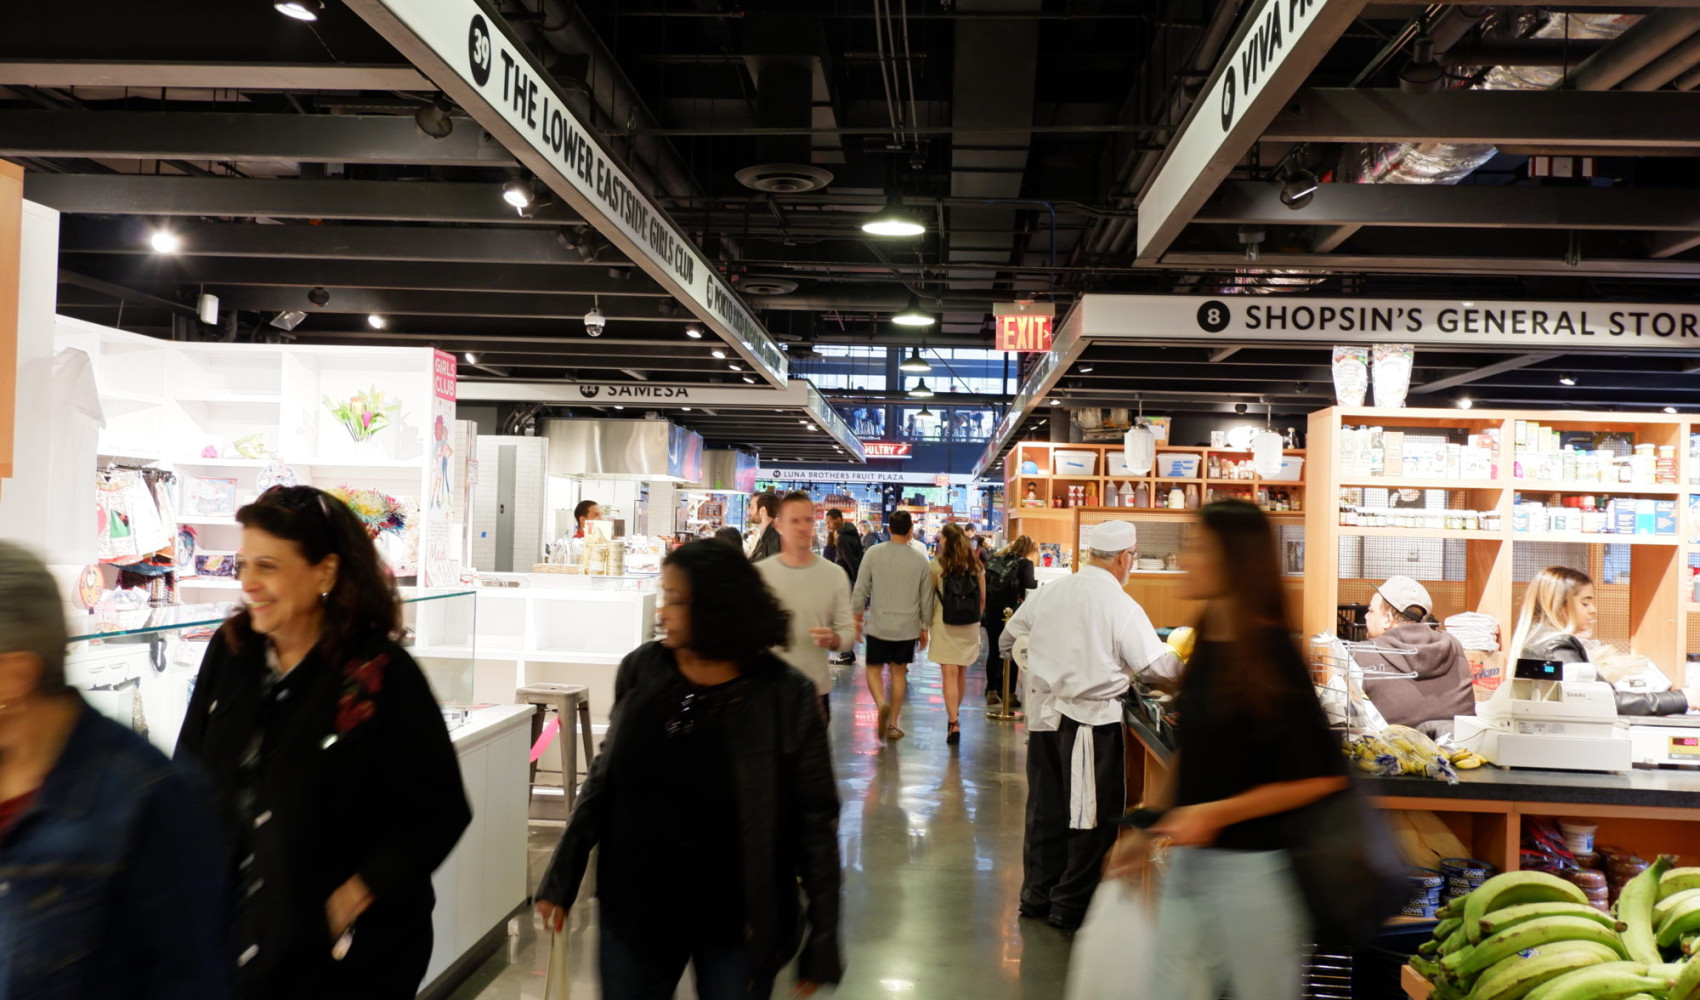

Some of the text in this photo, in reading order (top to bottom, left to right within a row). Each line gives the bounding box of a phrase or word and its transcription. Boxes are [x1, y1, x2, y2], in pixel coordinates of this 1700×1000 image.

[1242, 0, 1282, 96] VIVA
[473, 27, 694, 285] 39 THE LOWER EASTSIDE GIRLS CLUB
[1207, 305, 1700, 337] 8 SHOPSIN'S GENERAL STOR
[1003, 317, 1047, 350] EXIT
[435, 358, 455, 378] GIRLS
[435, 376, 455, 397] CLUB
[607, 385, 689, 397] SAMESA
[1423, 877, 1442, 887] GOYA
[1464, 869, 1484, 877] GOYA
[1402, 906, 1423, 914] GOYA
